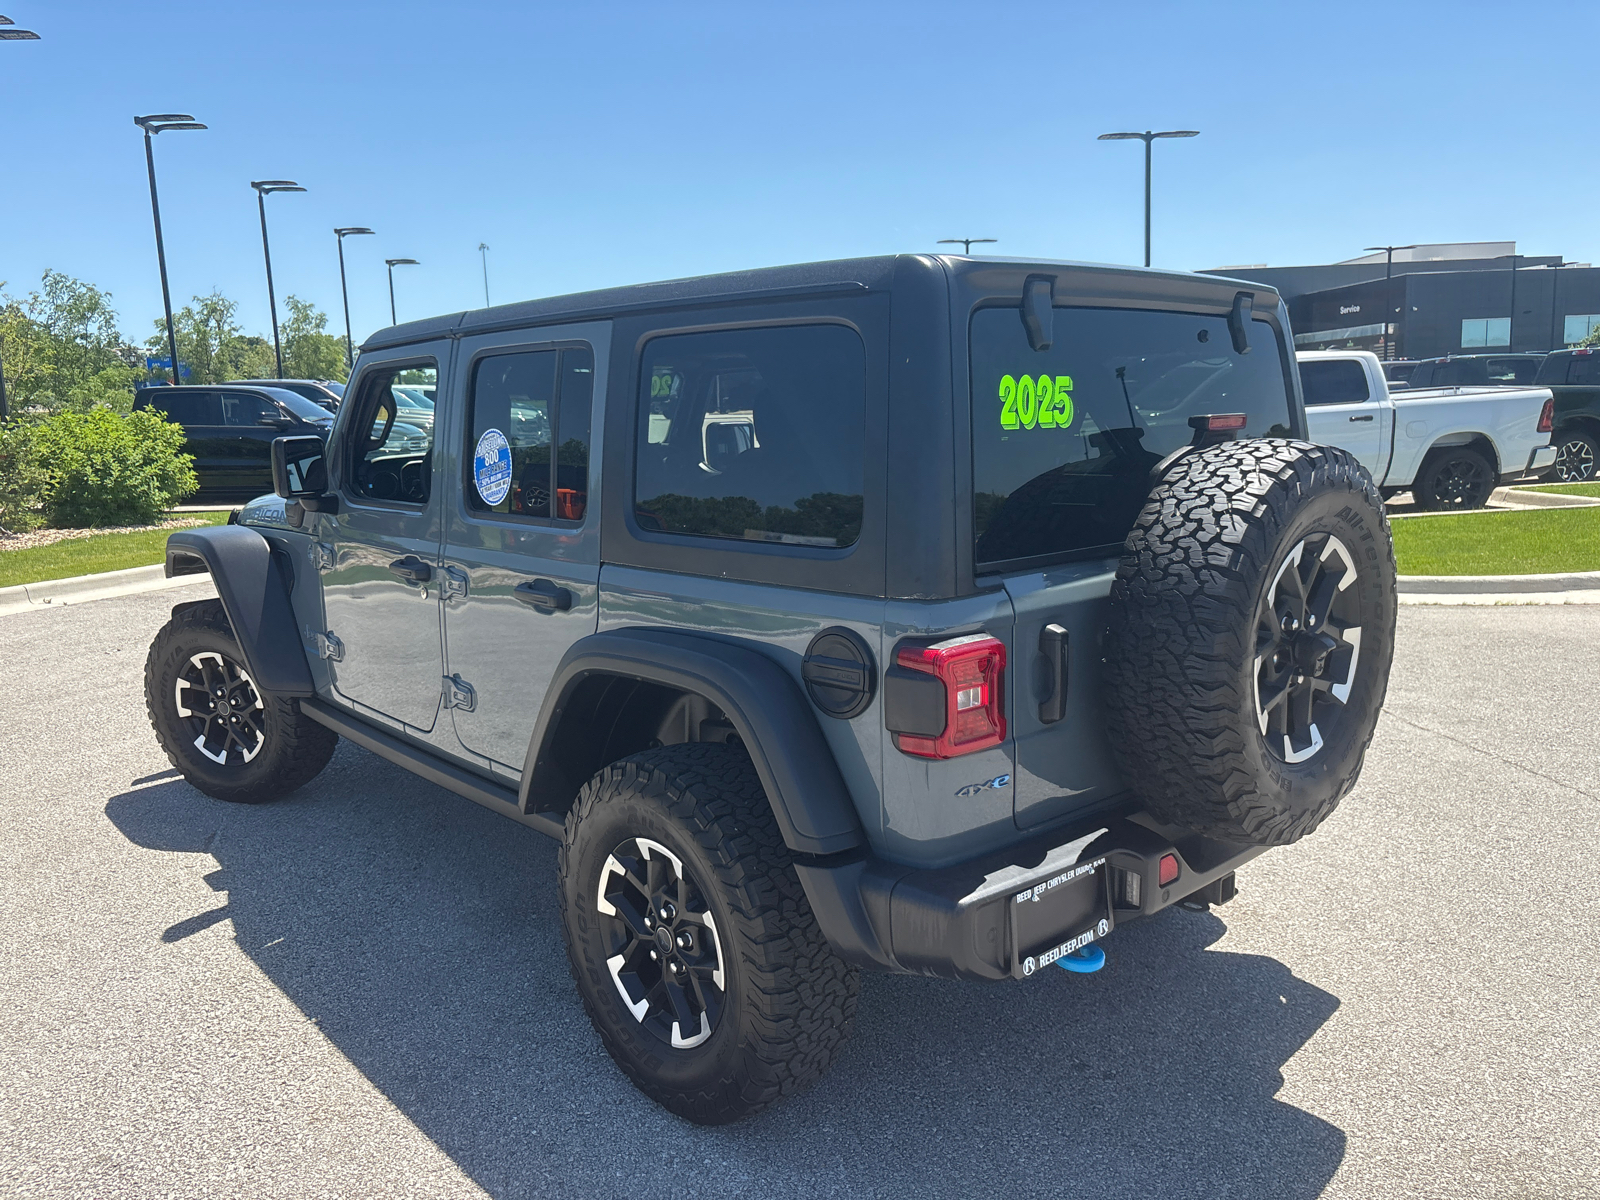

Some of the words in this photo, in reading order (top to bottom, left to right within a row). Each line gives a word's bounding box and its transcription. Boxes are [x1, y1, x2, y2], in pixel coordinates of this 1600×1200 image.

[1340, 304, 1360, 314] Service
[999, 374, 1074, 430] 2025
[485, 449, 499, 467] 800
[491, 460, 507, 474] RANGE
[836, 672, 856, 681] FUEL
[1016, 889, 1032, 904] REED
[1033, 882, 1047, 895] JEEP
[1047, 869, 1075, 889] CHRYSLER
[1040, 929, 1094, 968] REEDJEEP.COM
[575, 891, 665, 1074] BFGoodrich
